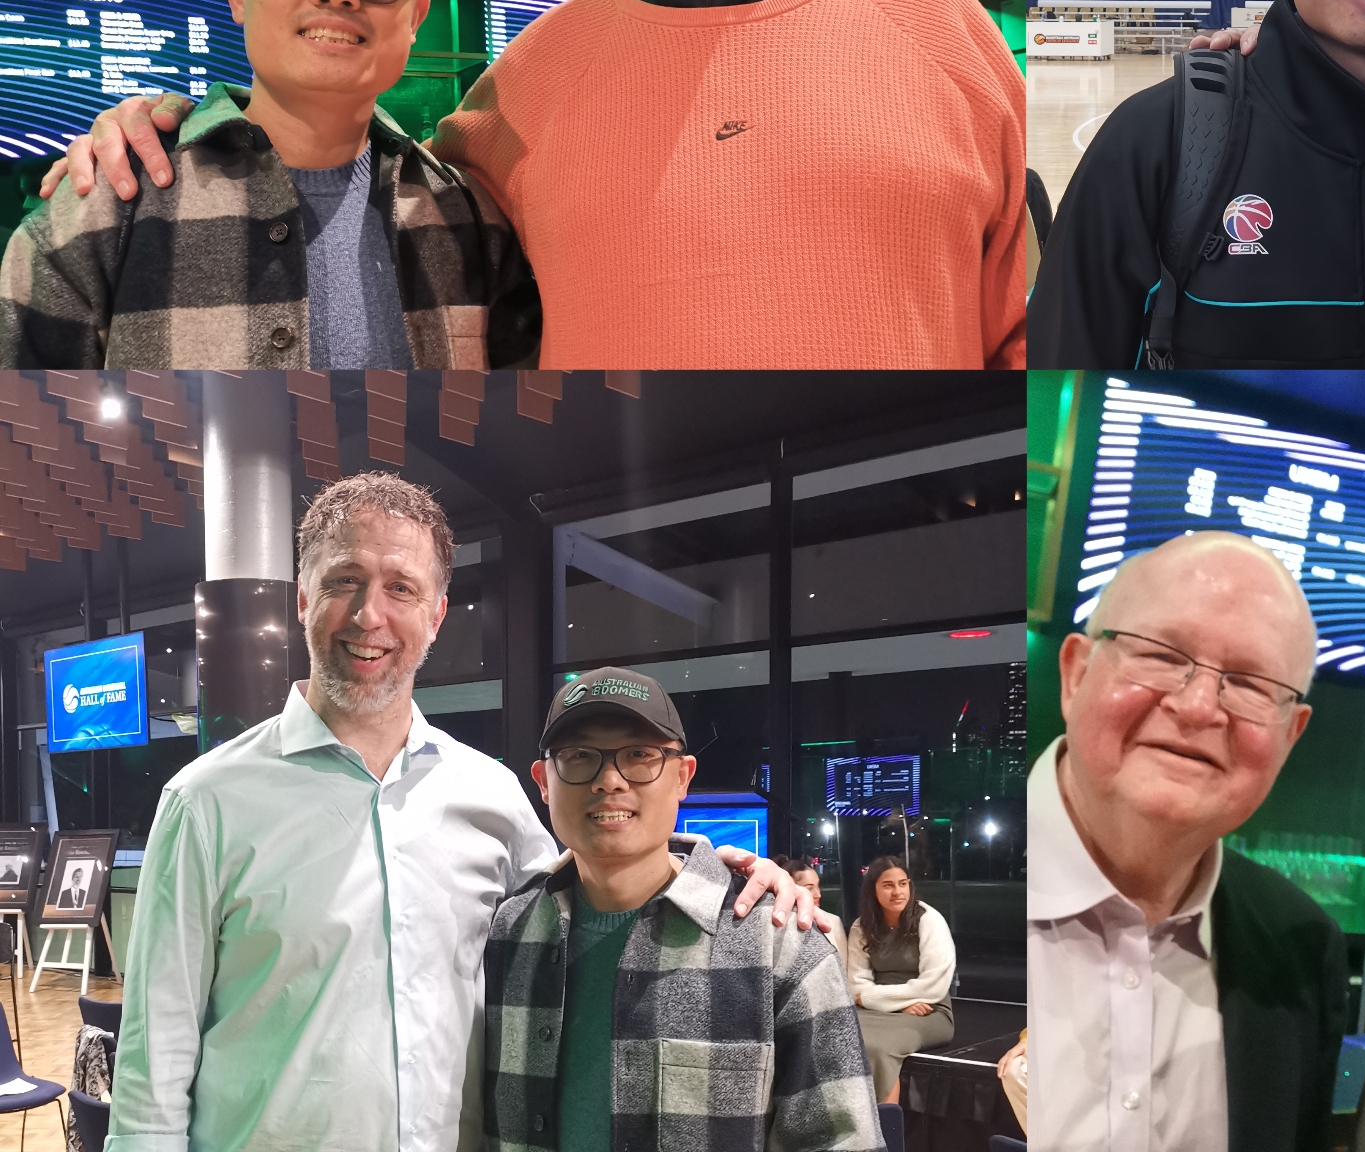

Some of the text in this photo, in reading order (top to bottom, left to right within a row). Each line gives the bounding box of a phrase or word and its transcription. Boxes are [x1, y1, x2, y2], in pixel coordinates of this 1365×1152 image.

[722, 120, 748, 131] NIKE
[1228, 242, 1269, 255] CBA
[591, 678, 649, 693] AUSTRALIAN
[80, 694, 100, 707] HALL
[106, 690, 127, 703] FAME
[591, 686, 650, 702] BOOMERS
